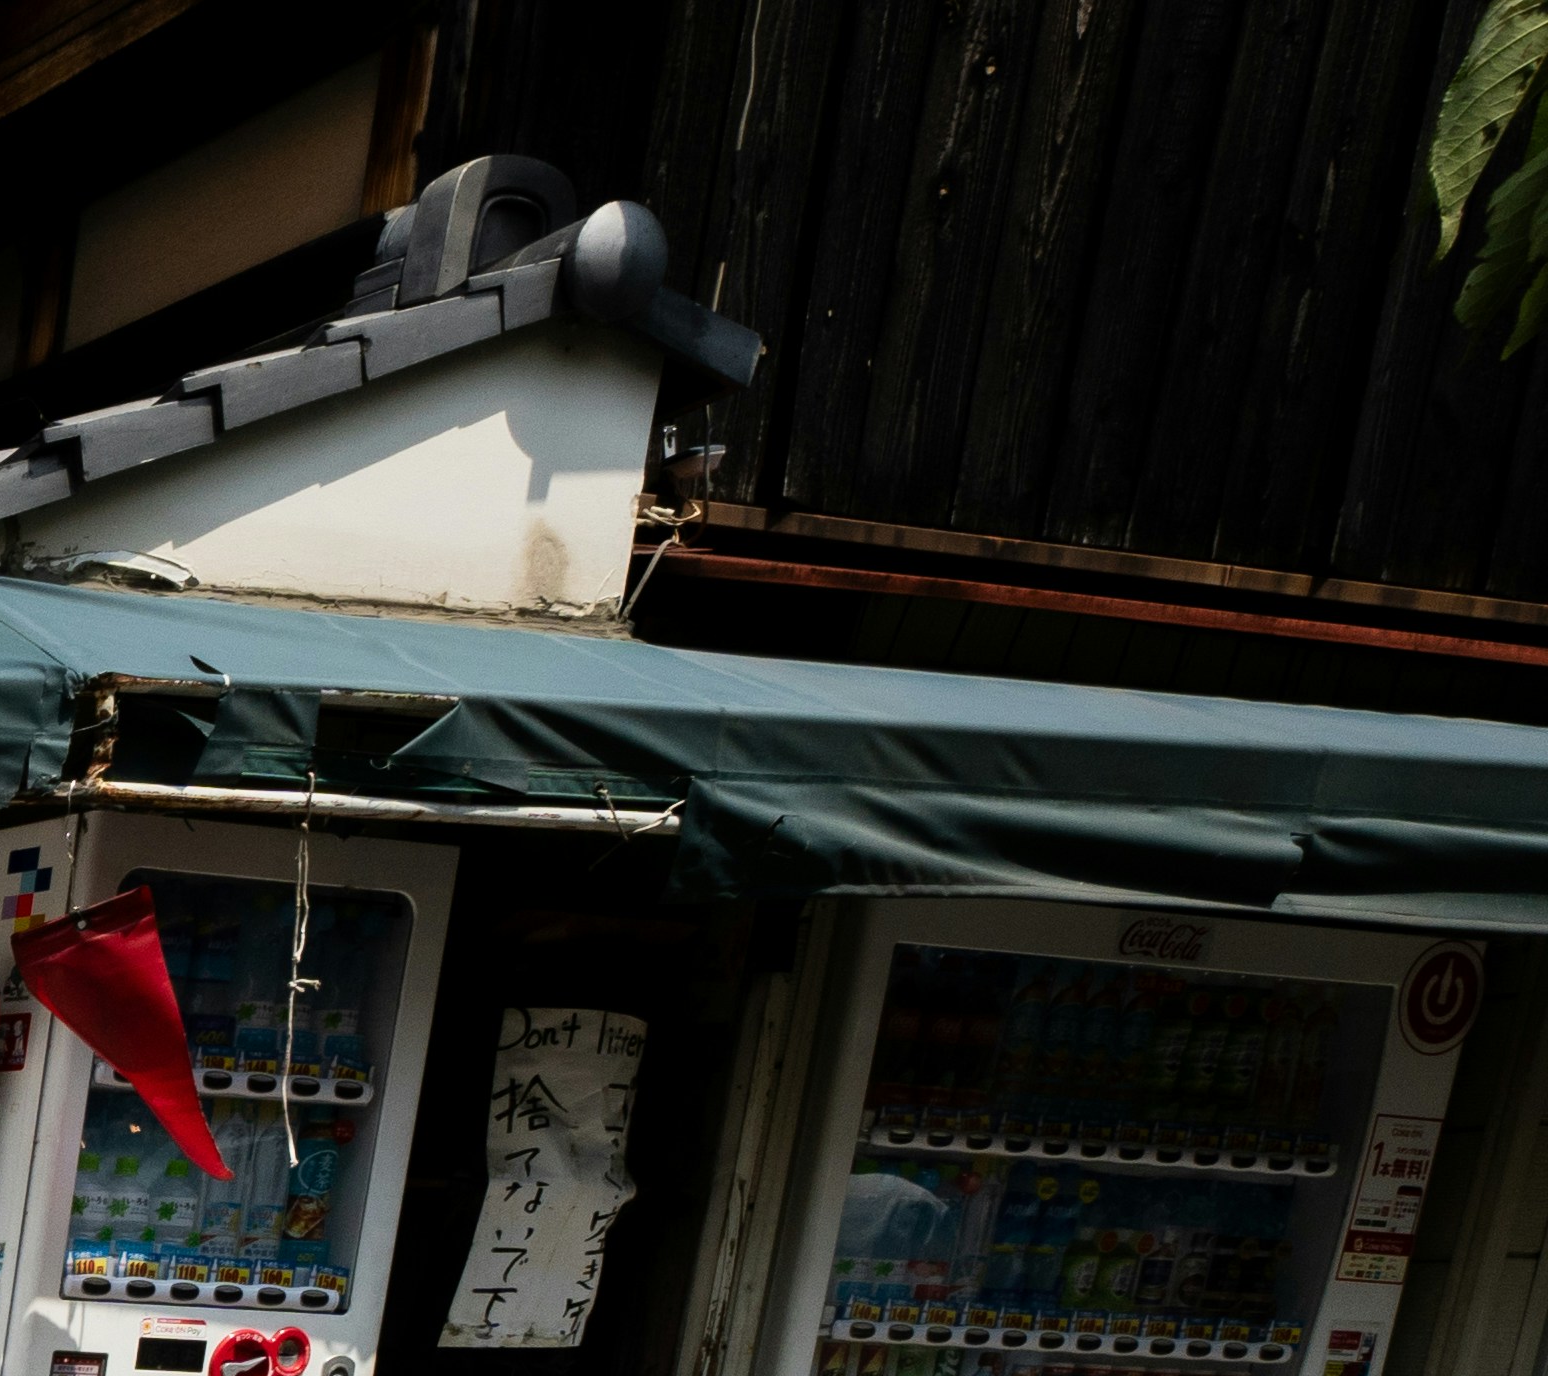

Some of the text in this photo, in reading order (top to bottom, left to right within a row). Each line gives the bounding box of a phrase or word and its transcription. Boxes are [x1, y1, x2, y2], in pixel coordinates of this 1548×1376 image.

[497, 1007, 580, 1051] Don't
[1372, 1141, 1429, 1181] 1本無料!
